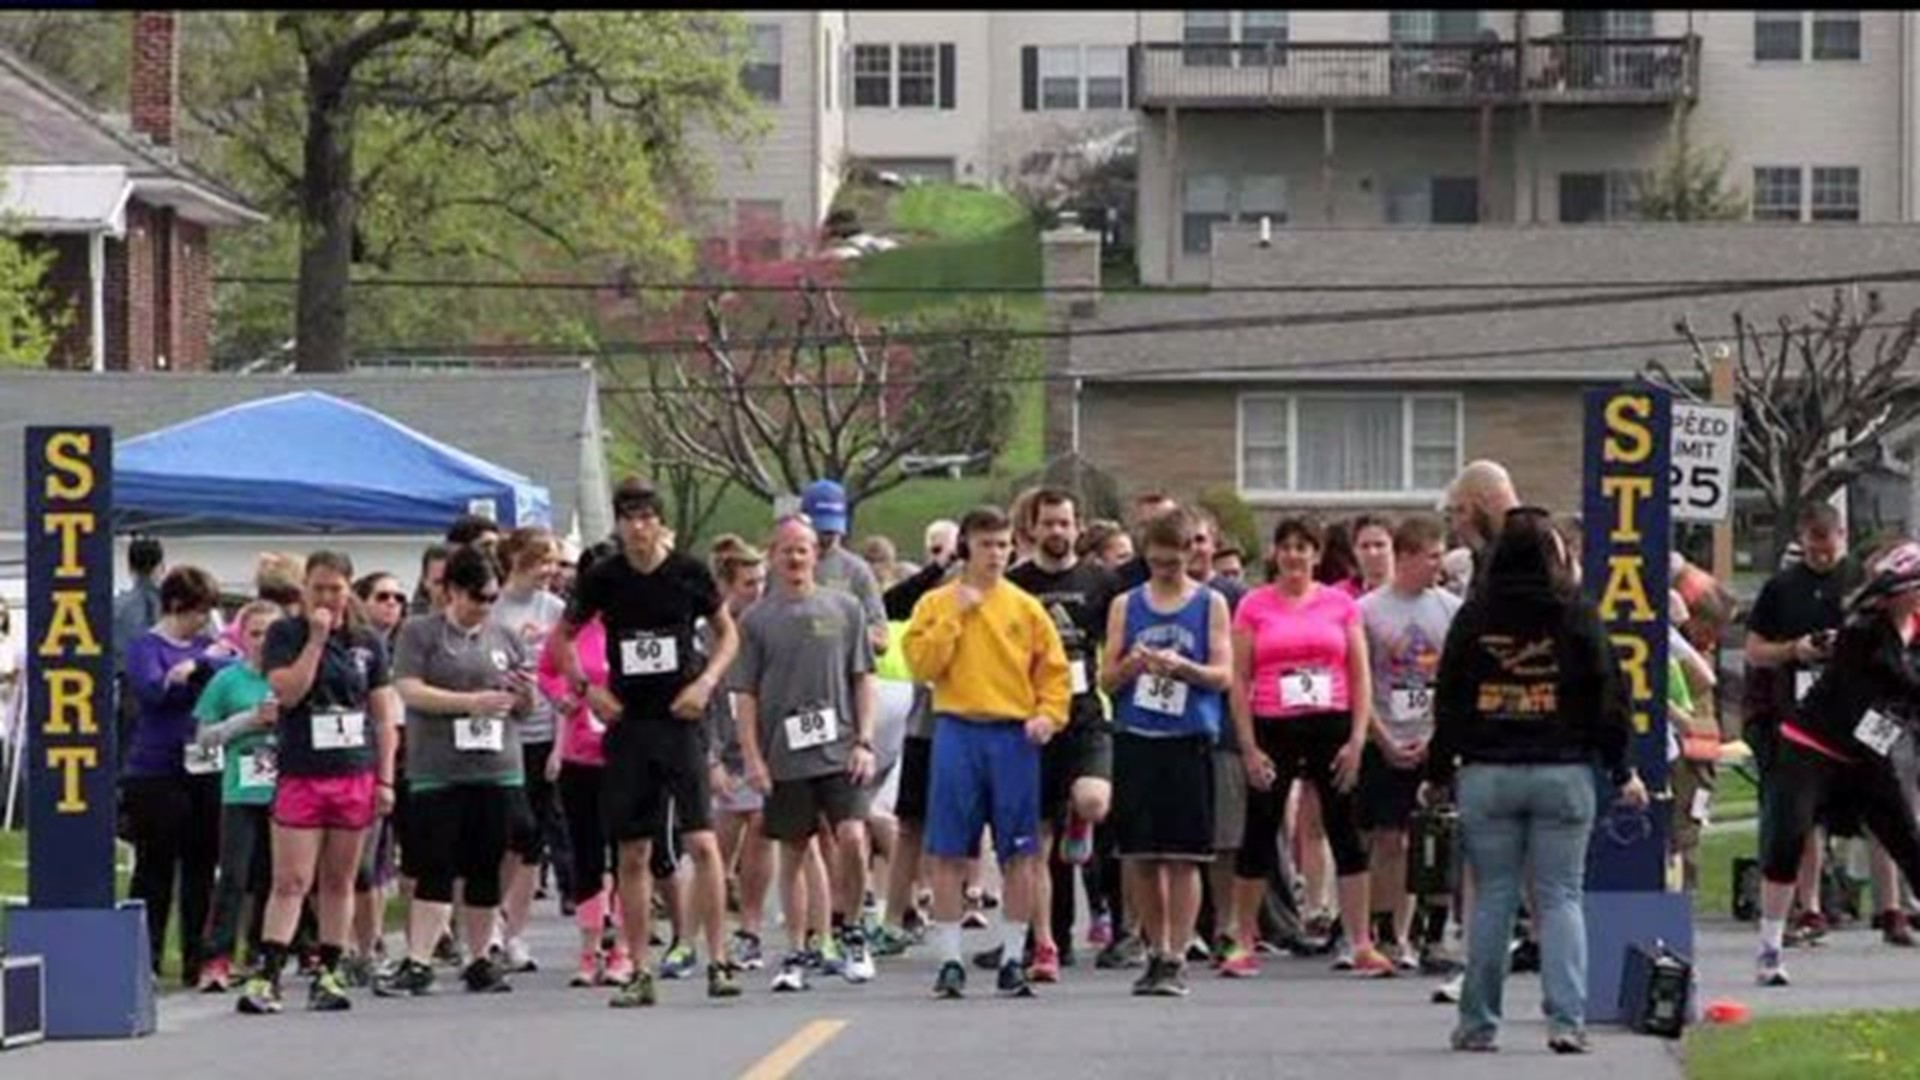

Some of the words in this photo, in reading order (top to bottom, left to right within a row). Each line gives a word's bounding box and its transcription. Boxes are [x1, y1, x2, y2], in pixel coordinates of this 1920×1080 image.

[1672, 411, 1728, 436] PEED
[1674, 441, 1715, 458] IMIT
[1600, 395, 1656, 734] STAR
[38, 432, 102, 812] START
[636, 639, 662, 660] 60
[1300, 671, 1313, 693] 9
[1406, 690, 1429, 710] 10
[801, 709, 825, 734] 80
